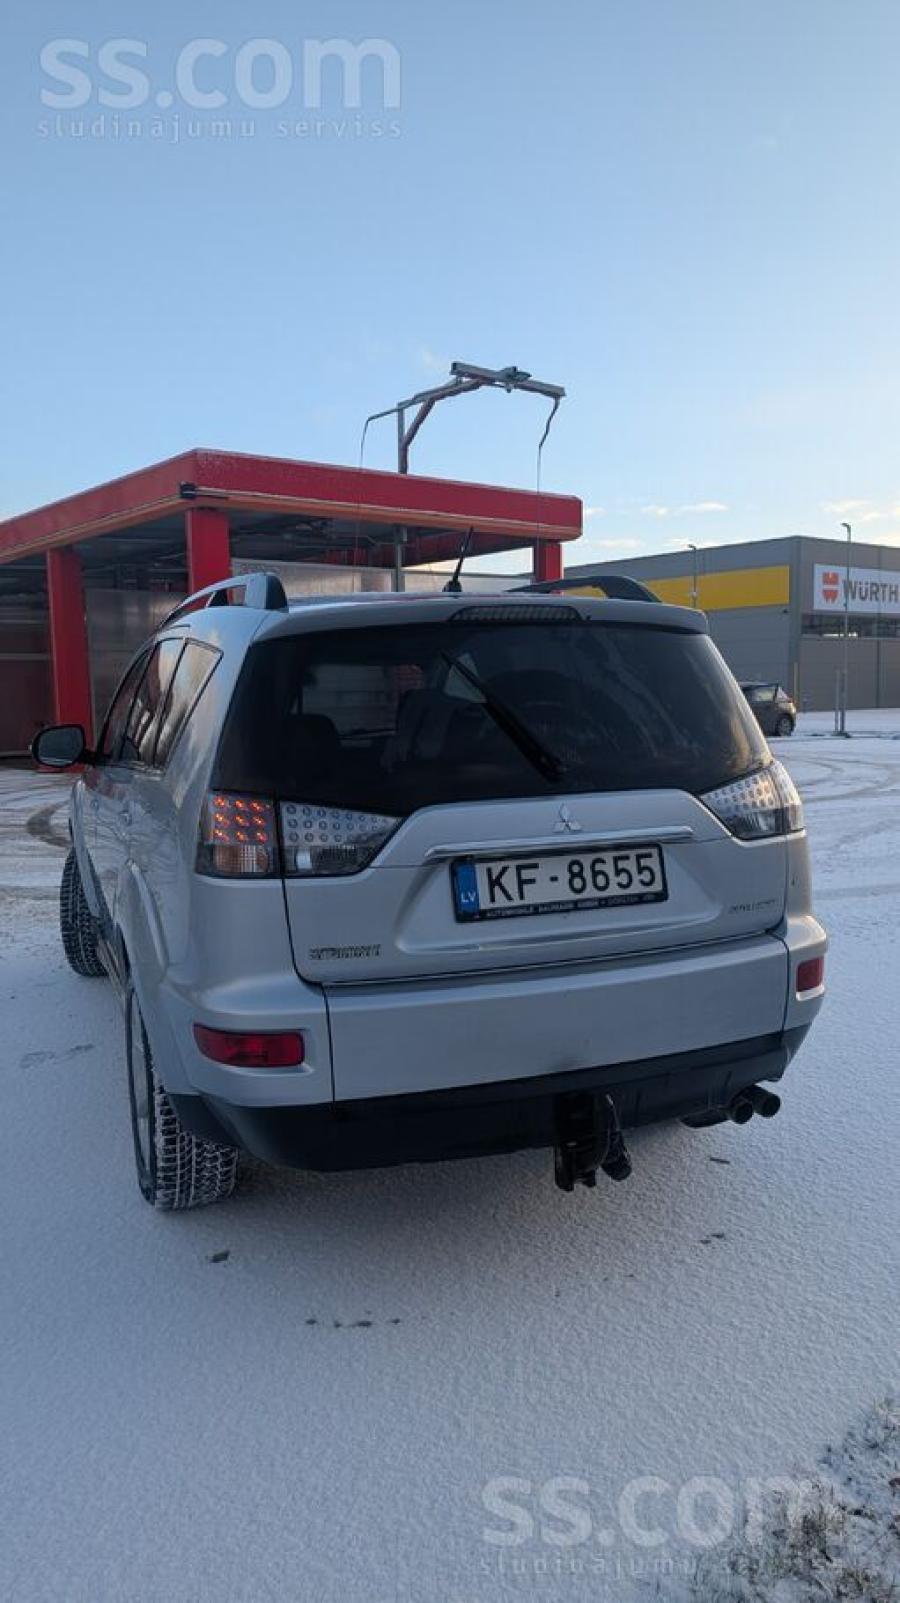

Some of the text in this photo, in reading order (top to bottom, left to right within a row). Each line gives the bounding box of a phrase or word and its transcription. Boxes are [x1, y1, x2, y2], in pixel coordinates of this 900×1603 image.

[842, 578, 899, 602] WÜRTH
[461, 891, 476, 903] LV
[486, 853, 656, 903] KF-8655
